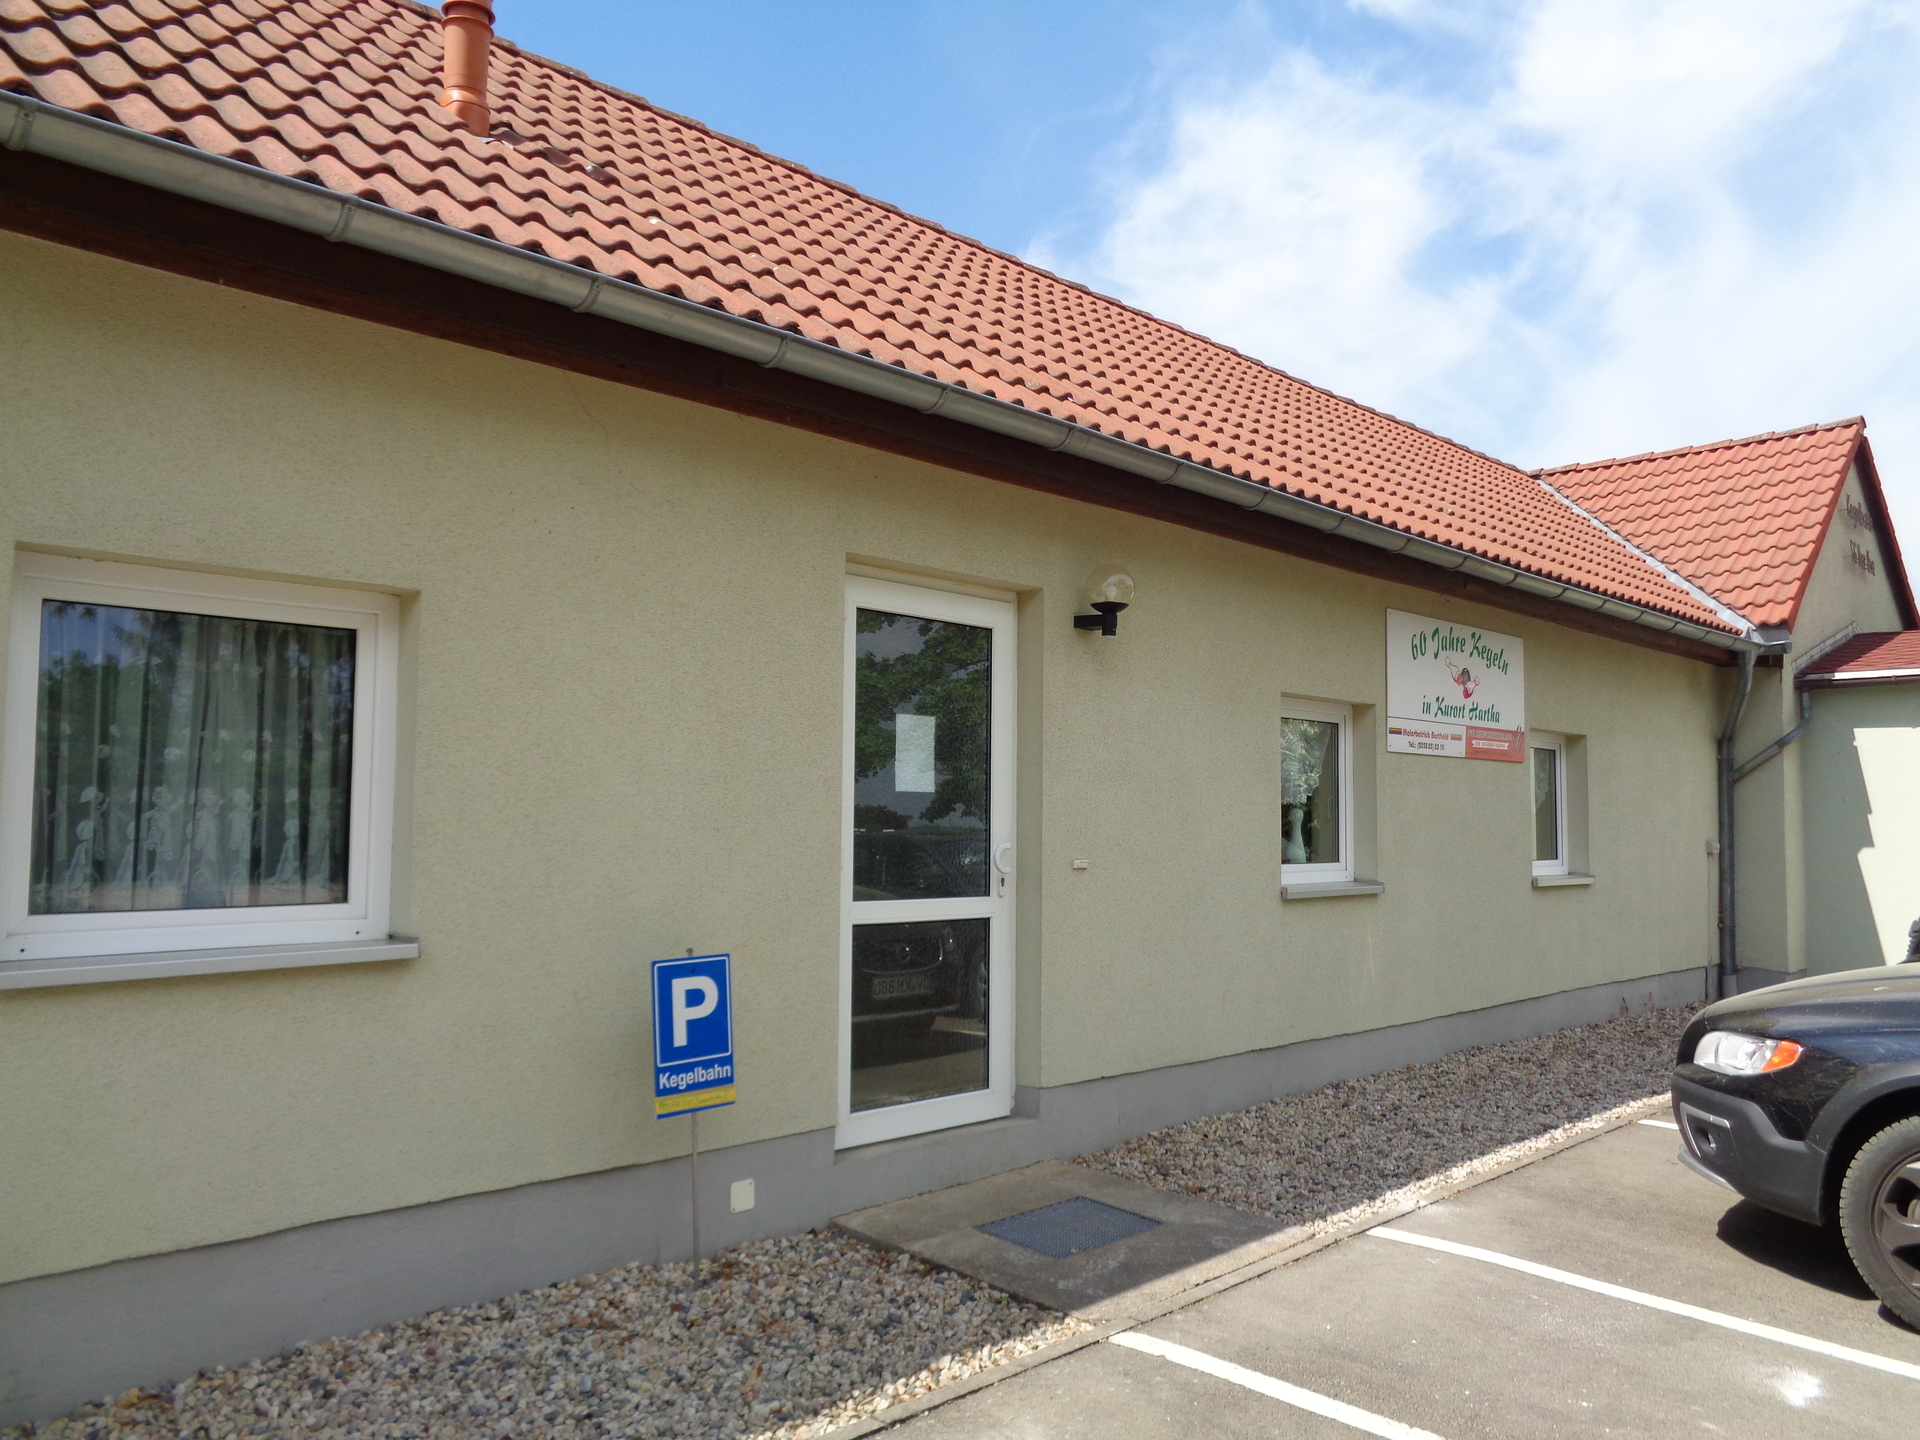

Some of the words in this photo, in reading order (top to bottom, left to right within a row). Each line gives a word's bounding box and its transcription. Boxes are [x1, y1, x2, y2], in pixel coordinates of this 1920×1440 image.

[1411, 630, 1427, 660] 60
[1431, 626, 1466, 660] Jahre
[1469, 631, 1509, 675] Kegeln
[1422, 695, 1432, 715] in
[1434, 695, 1466, 719] Kurort
[1468, 700, 1500, 724] Hartha
[671, 975, 719, 1047] P
[659, 1063, 732, 1090] Kegelbahn
